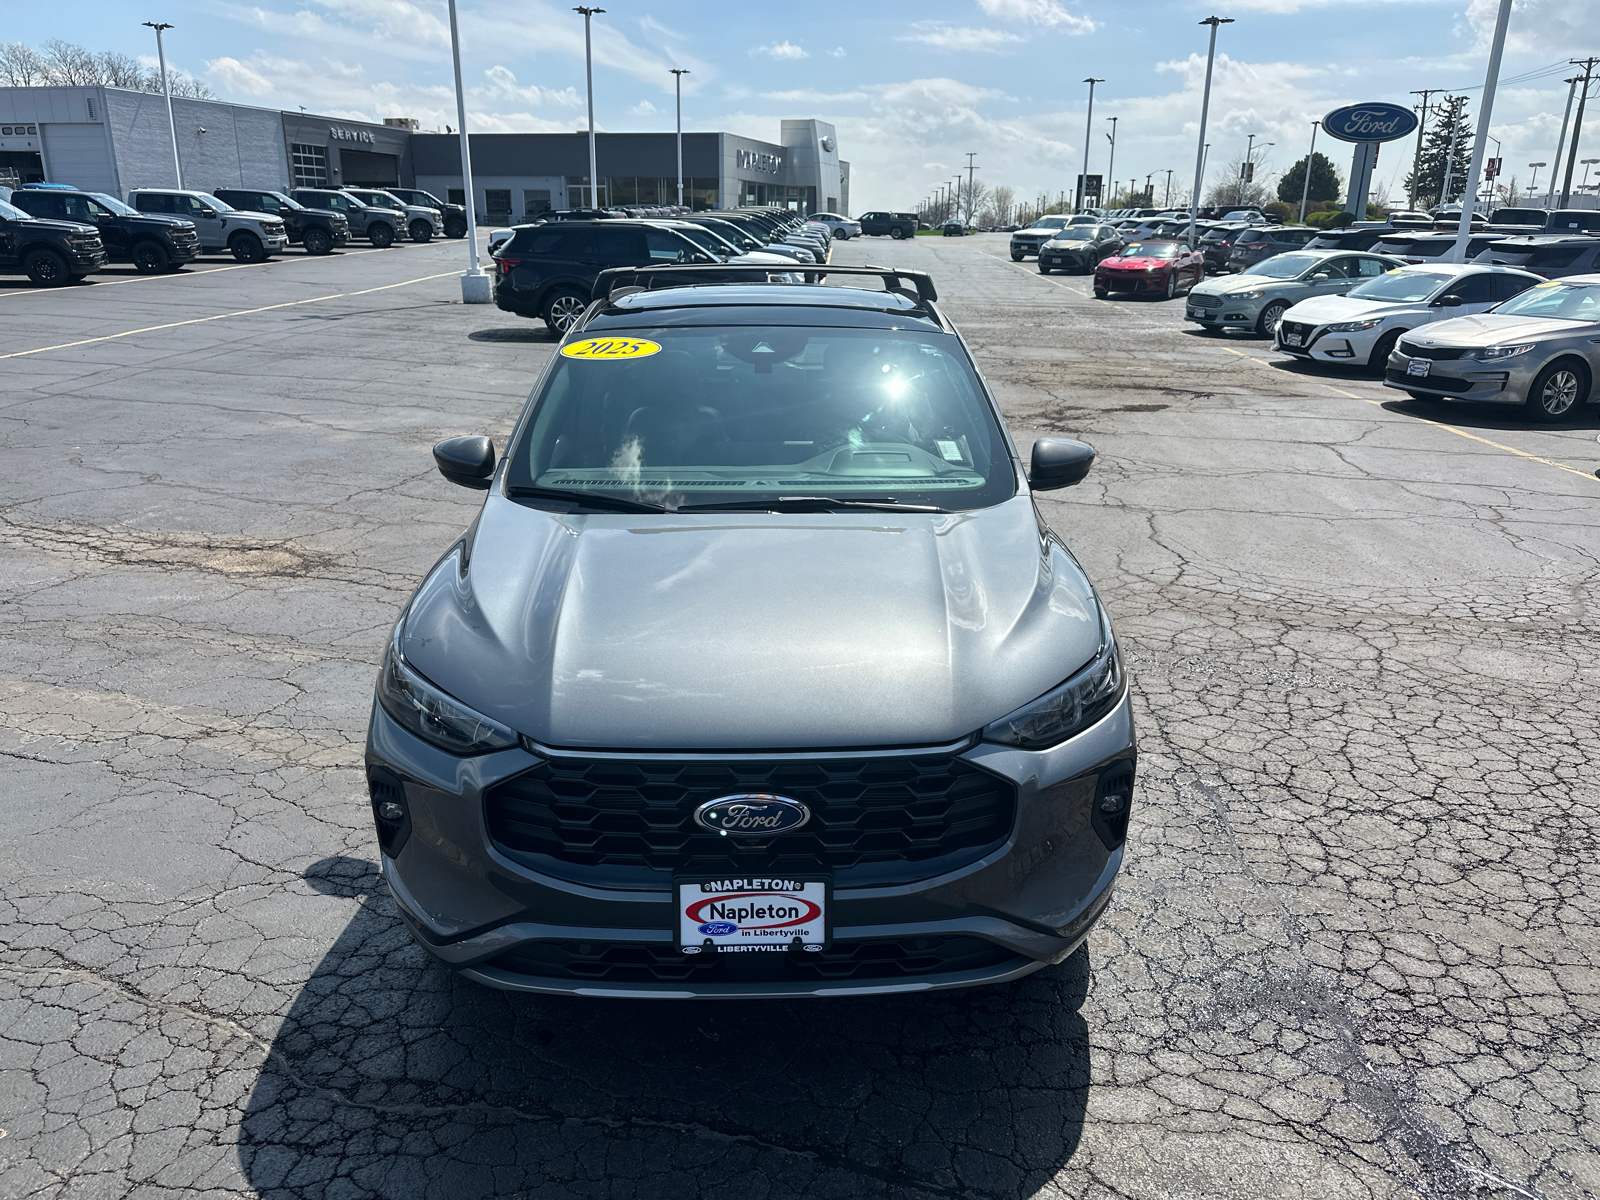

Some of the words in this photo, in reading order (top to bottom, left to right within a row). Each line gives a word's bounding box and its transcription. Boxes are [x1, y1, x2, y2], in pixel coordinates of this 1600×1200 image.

[1344, 110, 1400, 133] Ford
[331, 127, 376, 144] SERVICE
[737, 150, 782, 174] NAPLETON
[574, 342, 646, 355] 2025
[721, 804, 783, 828] Ford
[711, 879, 795, 892] NAPLETON
[710, 903, 799, 923] Napleton
[706, 923, 730, 934] Ford
[741, 929, 751, 937] in
[753, 929, 810, 938] Libertyville
[717, 945, 789, 953] LIBERTYVILLE
